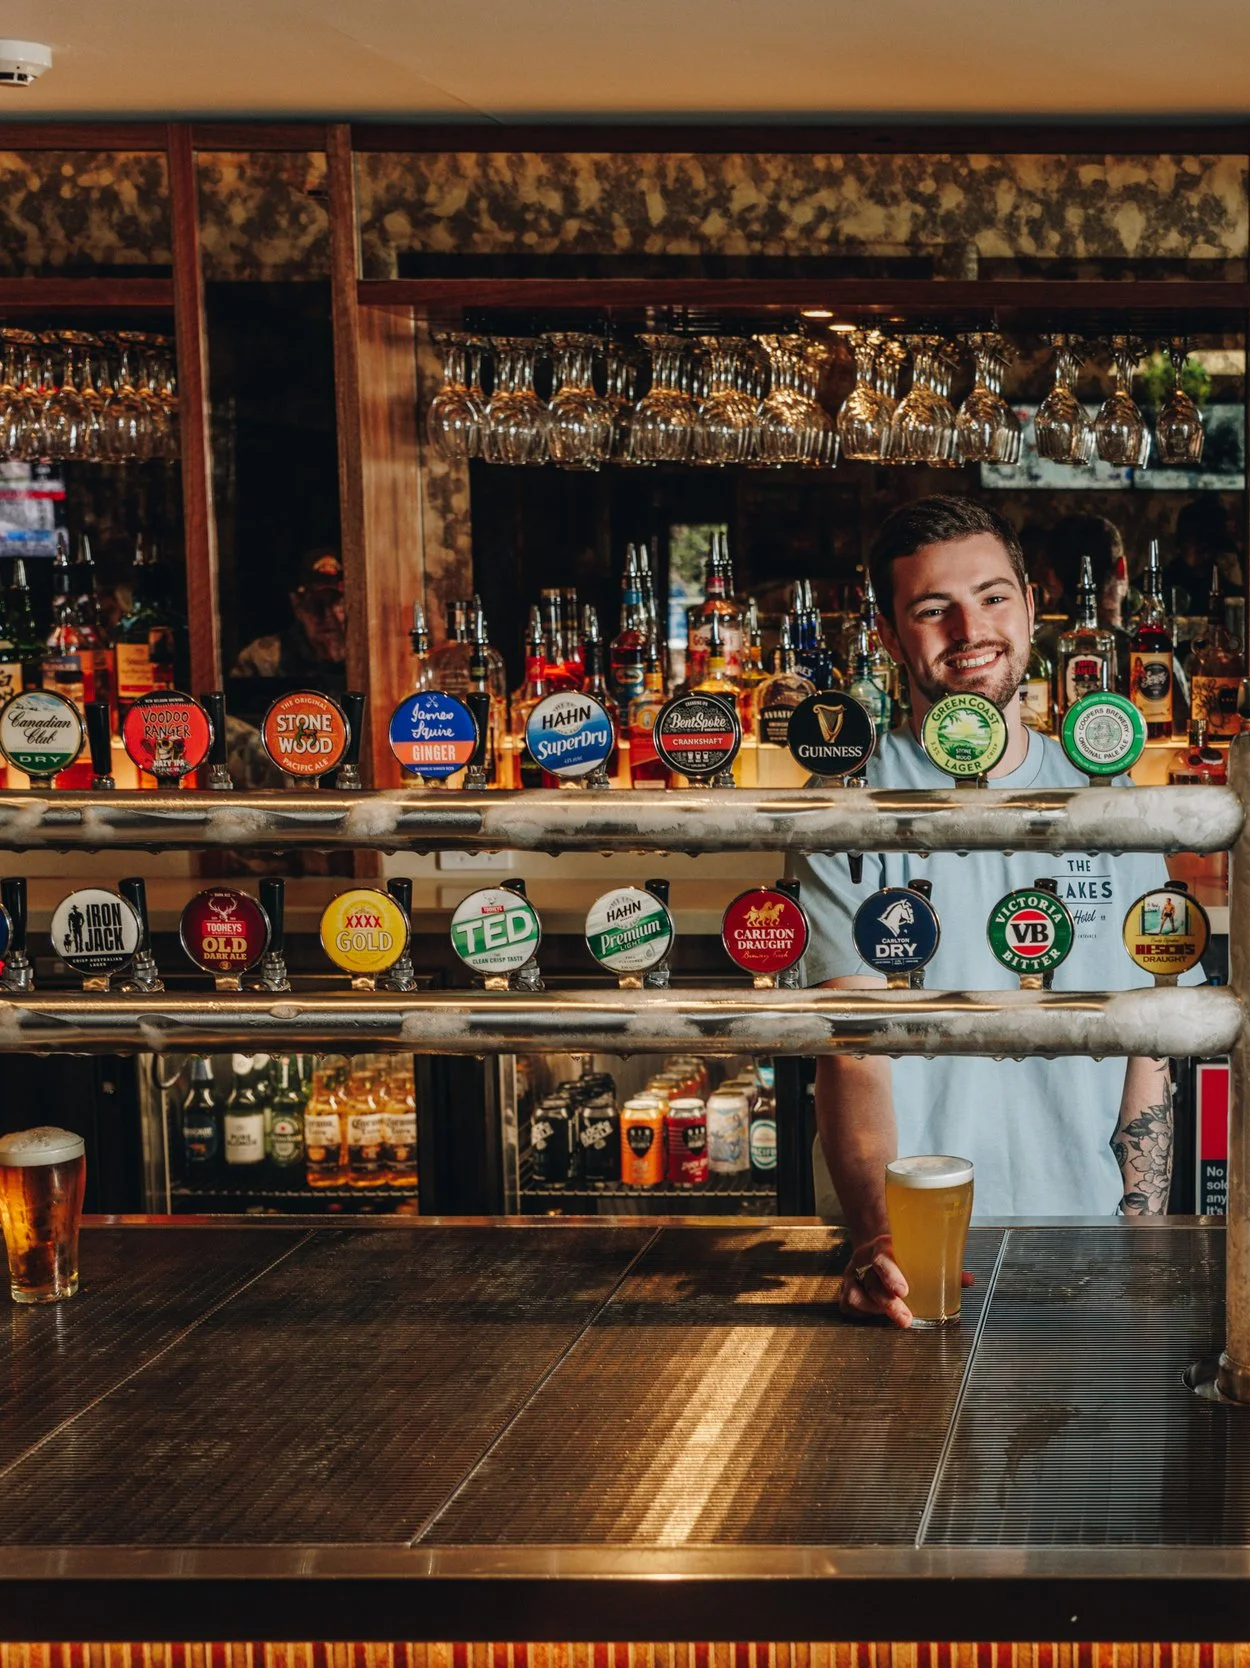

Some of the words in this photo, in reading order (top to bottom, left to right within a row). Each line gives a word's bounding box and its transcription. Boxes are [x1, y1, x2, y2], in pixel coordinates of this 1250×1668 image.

[280, 700, 294, 711] THE
[295, 697, 328, 711] ORIGINAL
[411, 702, 454, 723] James
[931, 698, 966, 722] GREEN
[968, 697, 1000, 725] COAST
[8, 711, 72, 728] Canadian
[142, 710, 190, 723] VOODOO
[276, 713, 333, 732] STONE
[542, 705, 592, 730] HAHN
[669, 712, 726, 732] BentSpoke
[1078, 708, 1104, 731] COOPERS
[1106, 708, 1130, 733] BREWERY
[24, 728, 57, 744] Club
[145, 724, 191, 738] RANGER
[411, 719, 456, 740] Squire
[278, 736, 333, 754] WOOD
[537, 730, 608, 760] SuperDry
[672, 738, 723, 746] CRANKSHAFT
[1078, 736, 1102, 760] ORIGINAL
[1103, 749, 1120, 760] PALE
[1119, 739, 1129, 755] ALE
[412, 744, 456, 761] GINGER
[798, 744, 863, 758] GUINNESS
[282, 757, 314, 771] PACIFIC
[314, 758, 330, 770] ALE
[944, 759, 982, 772] LAGER
[1067, 860, 1091, 872] THE
[86, 903, 122, 927] IRON
[606, 900, 642, 922] HAHN
[995, 896, 1063, 923] VICTORIA
[1073, 909, 1097, 925] Hotel
[206, 923, 243, 932] TOOHEYS
[345, 914, 383, 928] XXXX
[85, 926, 125, 951] JACK
[456, 910, 534, 954] TED
[600, 919, 662, 955] Premium
[734, 929, 795, 939] CARLTON
[1010, 923, 1049, 943] VB
[202, 936, 248, 953] OLD
[336, 931, 393, 952] GOLD
[620, 940, 641, 951] LIGHT
[738, 940, 793, 949] DRAUGHT
[875, 943, 918, 957] DRY
[1002, 948, 1061, 970] BITTER
[1206, 1166, 1223, 1177] No
